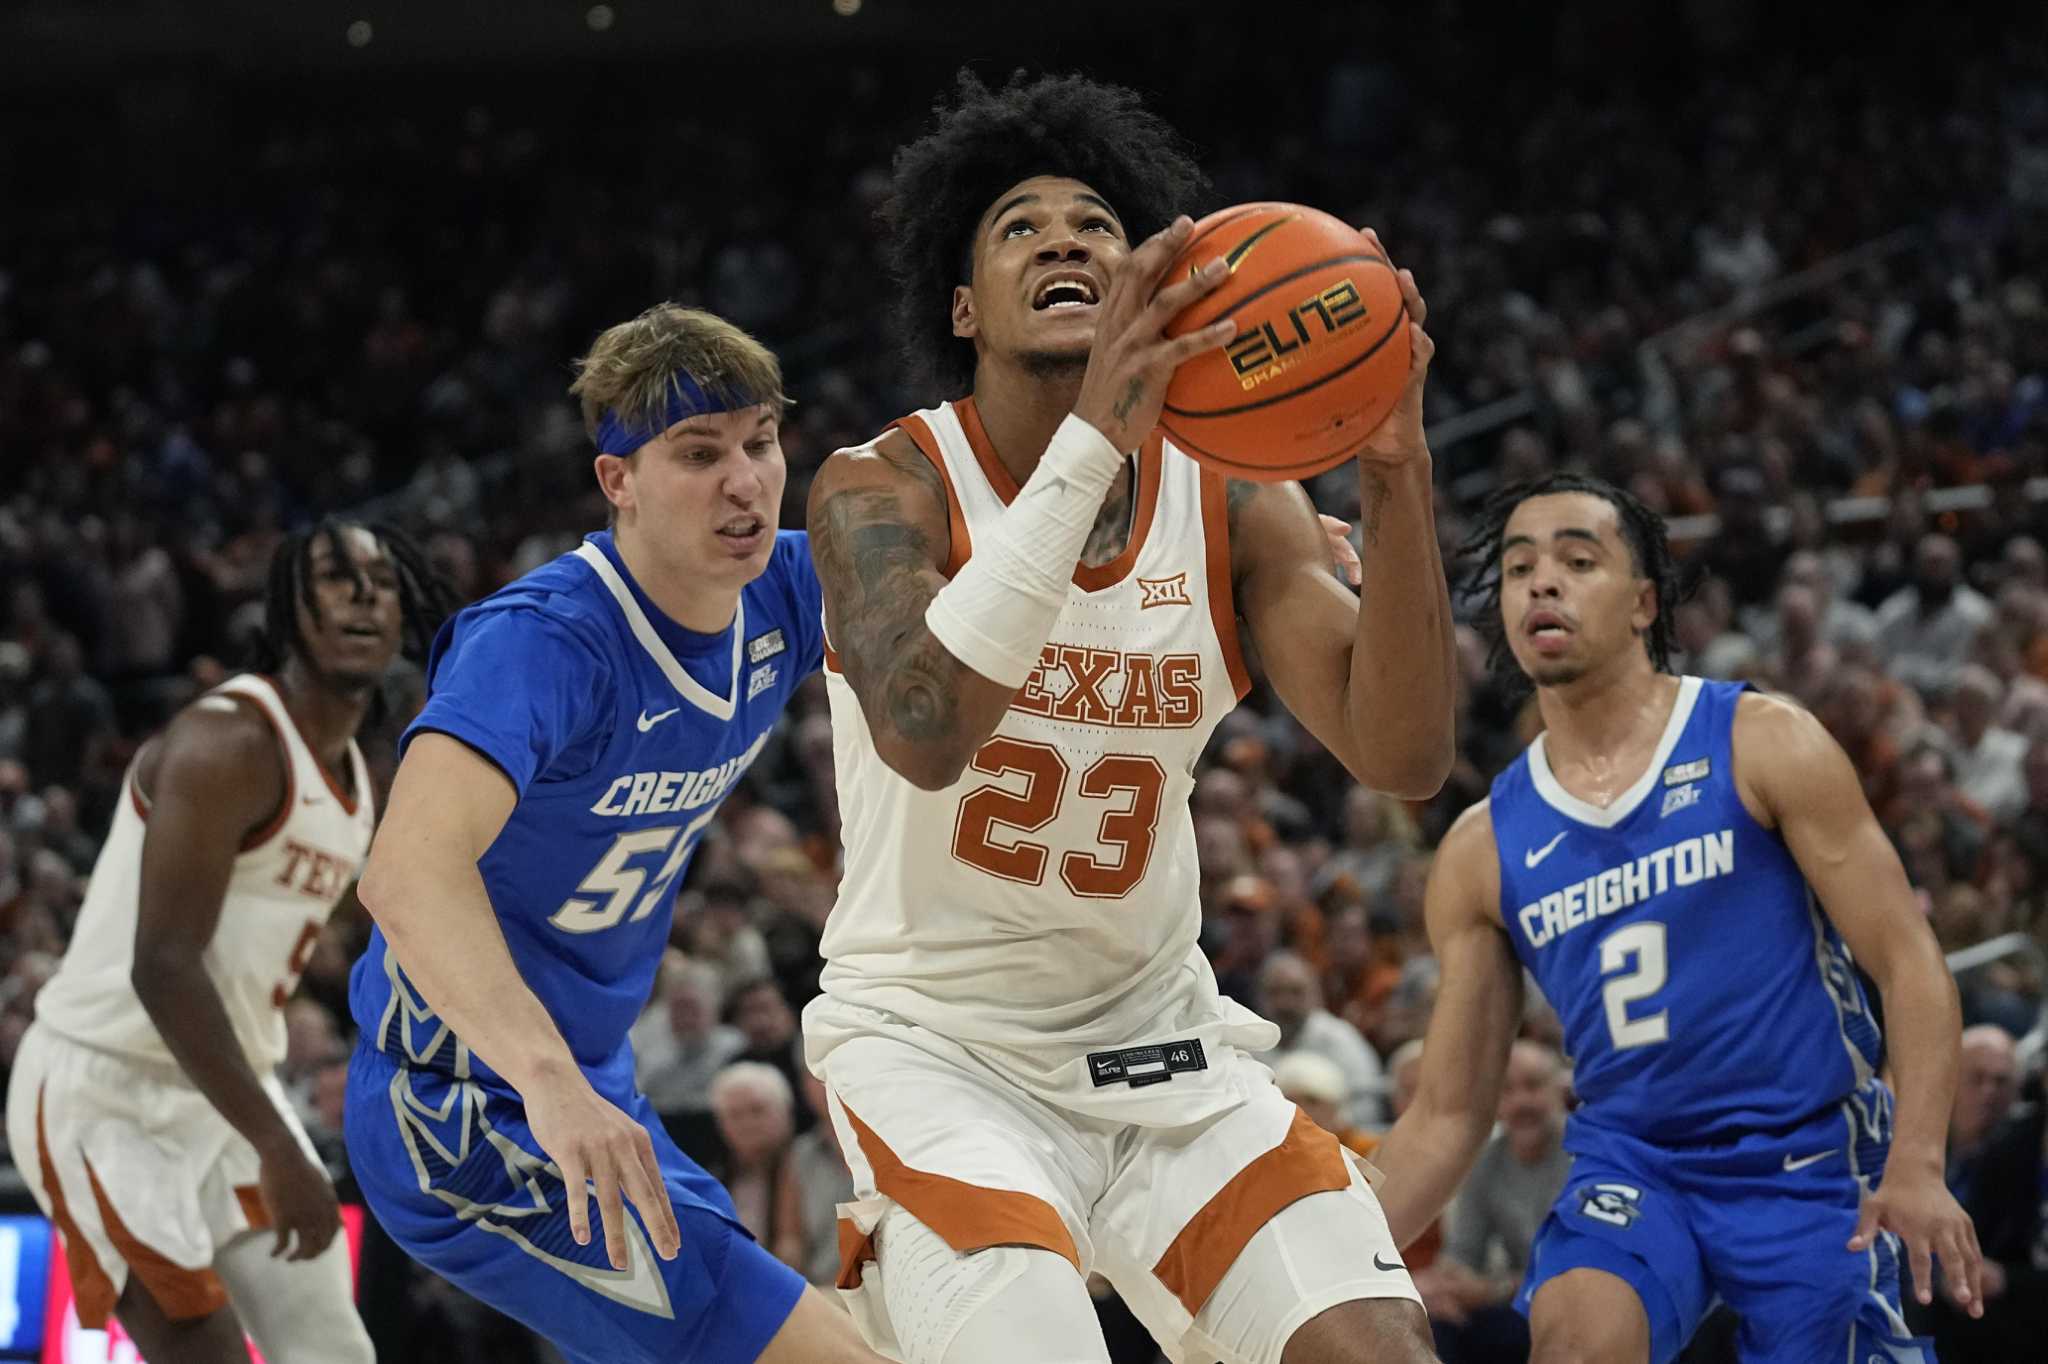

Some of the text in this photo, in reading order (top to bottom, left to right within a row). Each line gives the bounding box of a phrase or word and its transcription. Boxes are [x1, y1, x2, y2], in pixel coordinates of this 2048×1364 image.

[1223, 278, 1367, 381] ELITE
[1009, 642, 1202, 729] EXAS
[951, 735, 1167, 899] 23
[1518, 830, 1734, 948] CREIGHTON
[1600, 921, 1669, 1050] 2
[1171, 1050, 1189, 1063] 46
